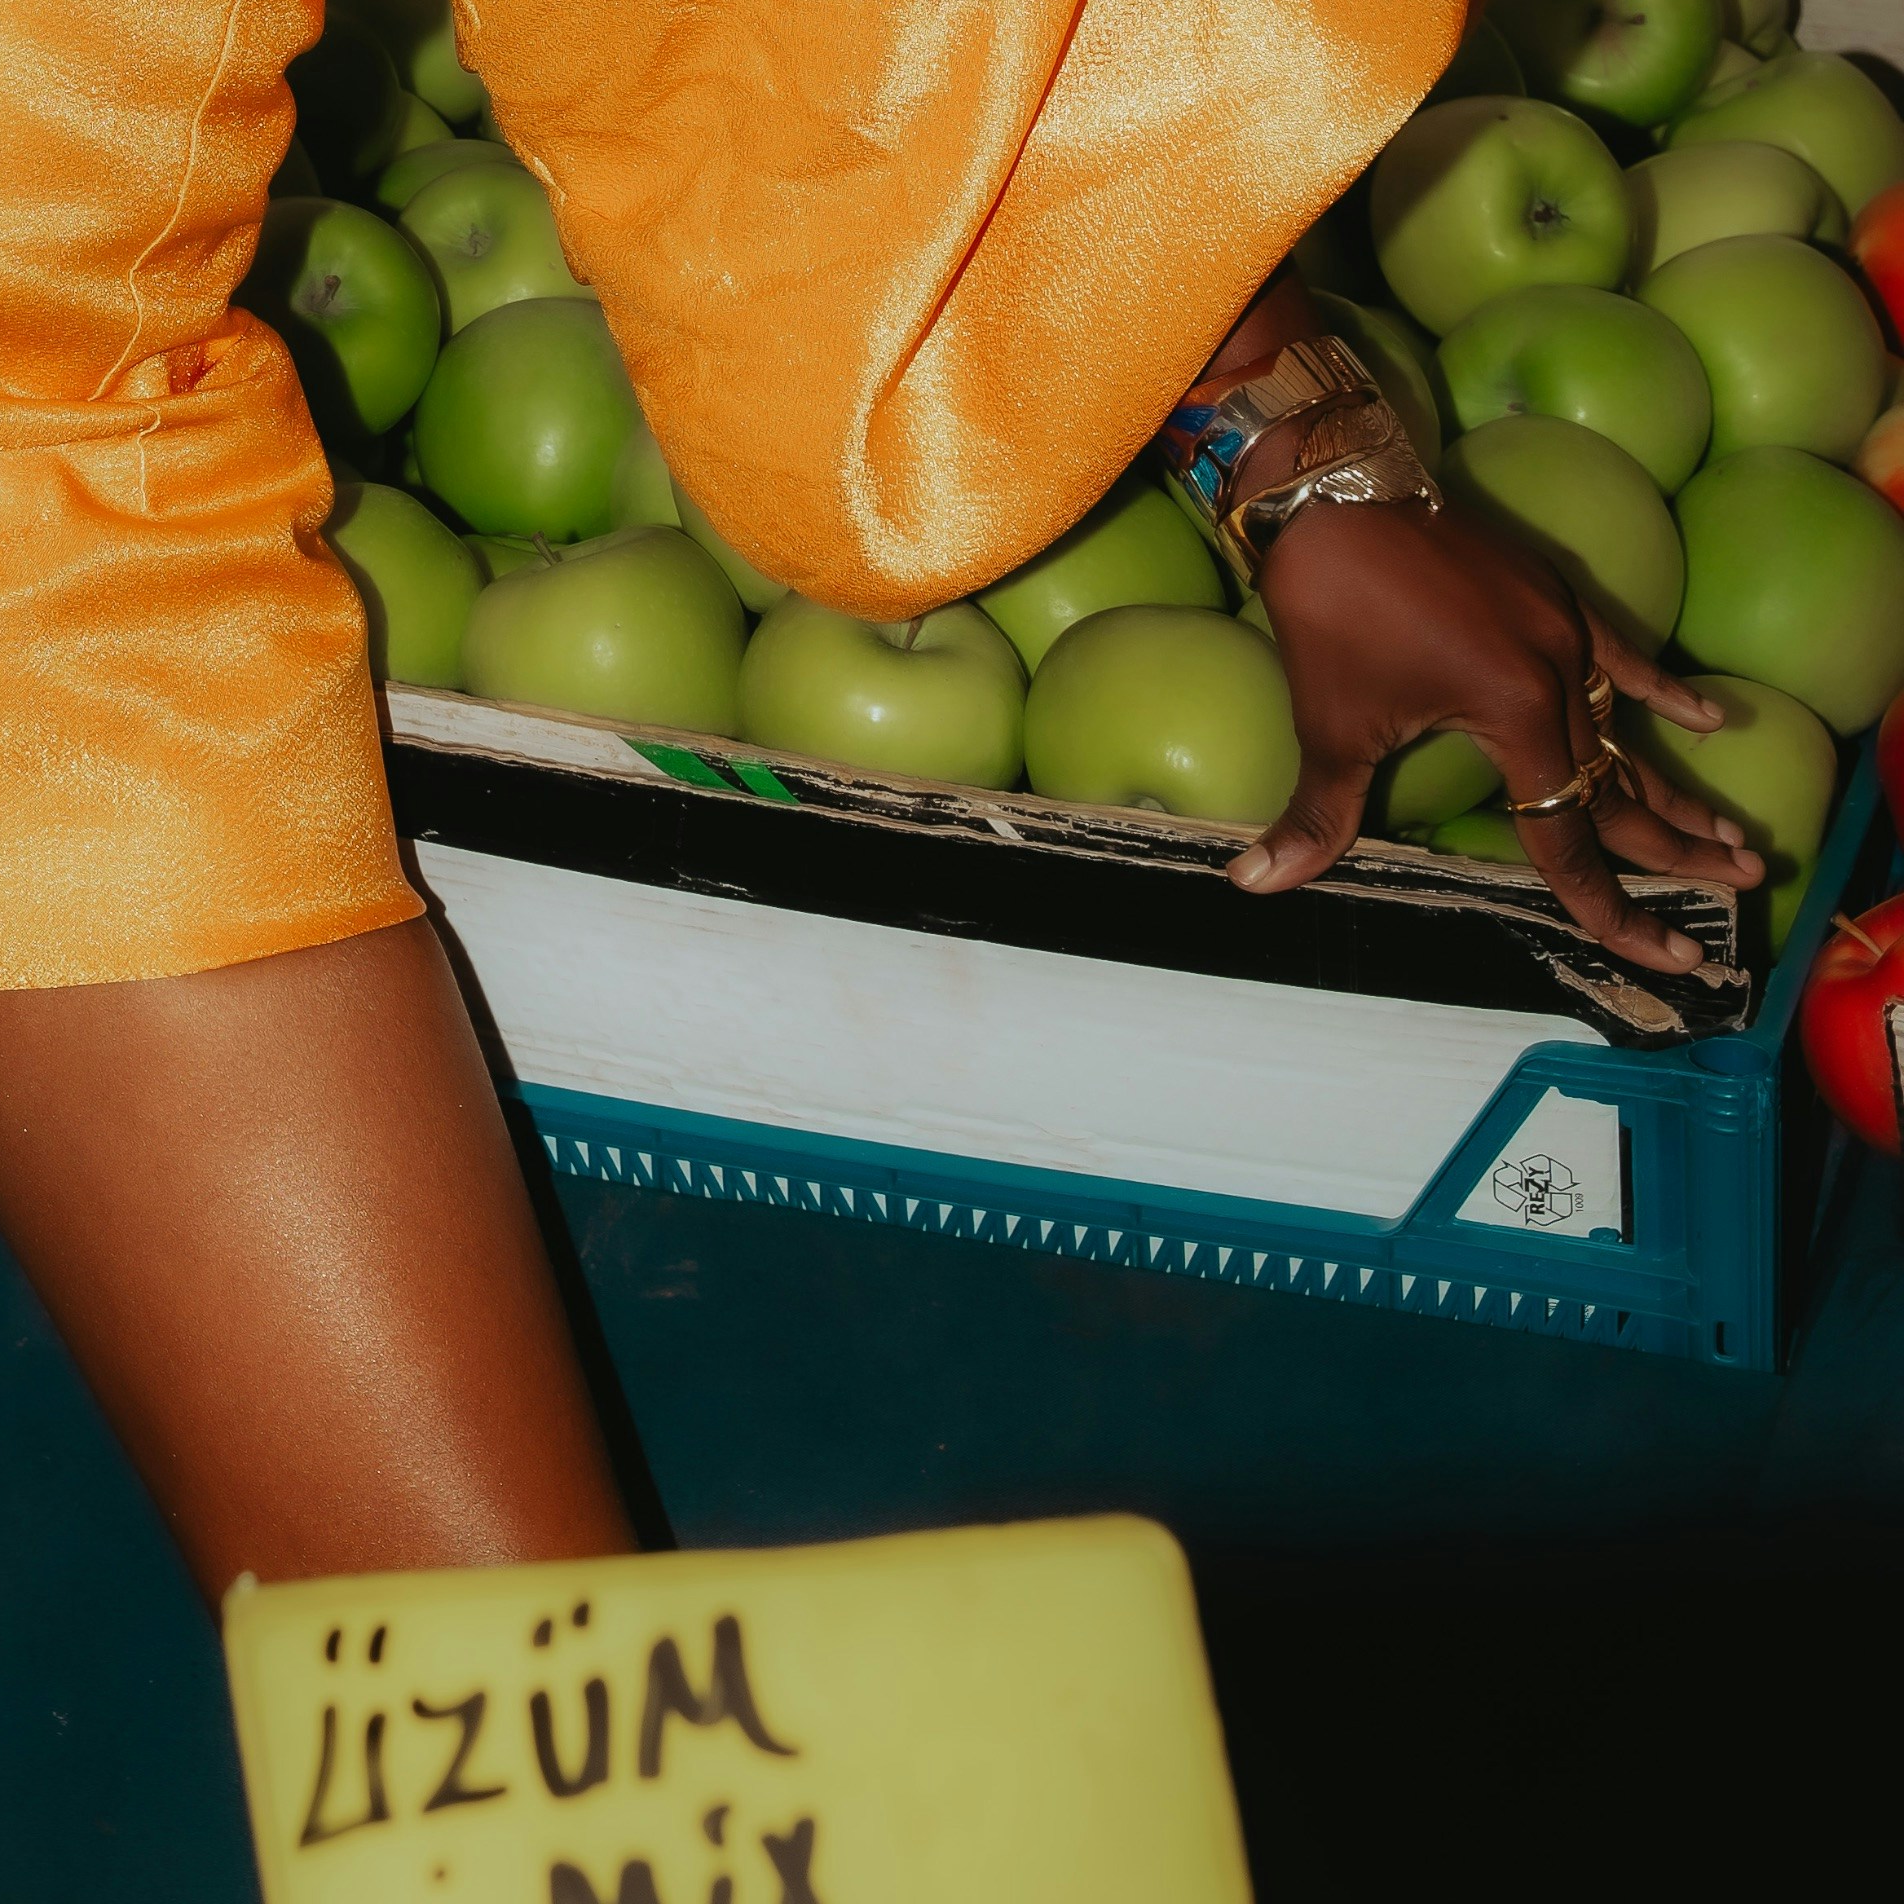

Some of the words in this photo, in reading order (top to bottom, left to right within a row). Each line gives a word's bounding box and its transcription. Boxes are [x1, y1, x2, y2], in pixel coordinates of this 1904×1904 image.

[1524, 1166, 1550, 1215] REZY
[1574, 1193, 1584, 1212] 1009
[296, 1598, 800, 1849] ÜZÜM
